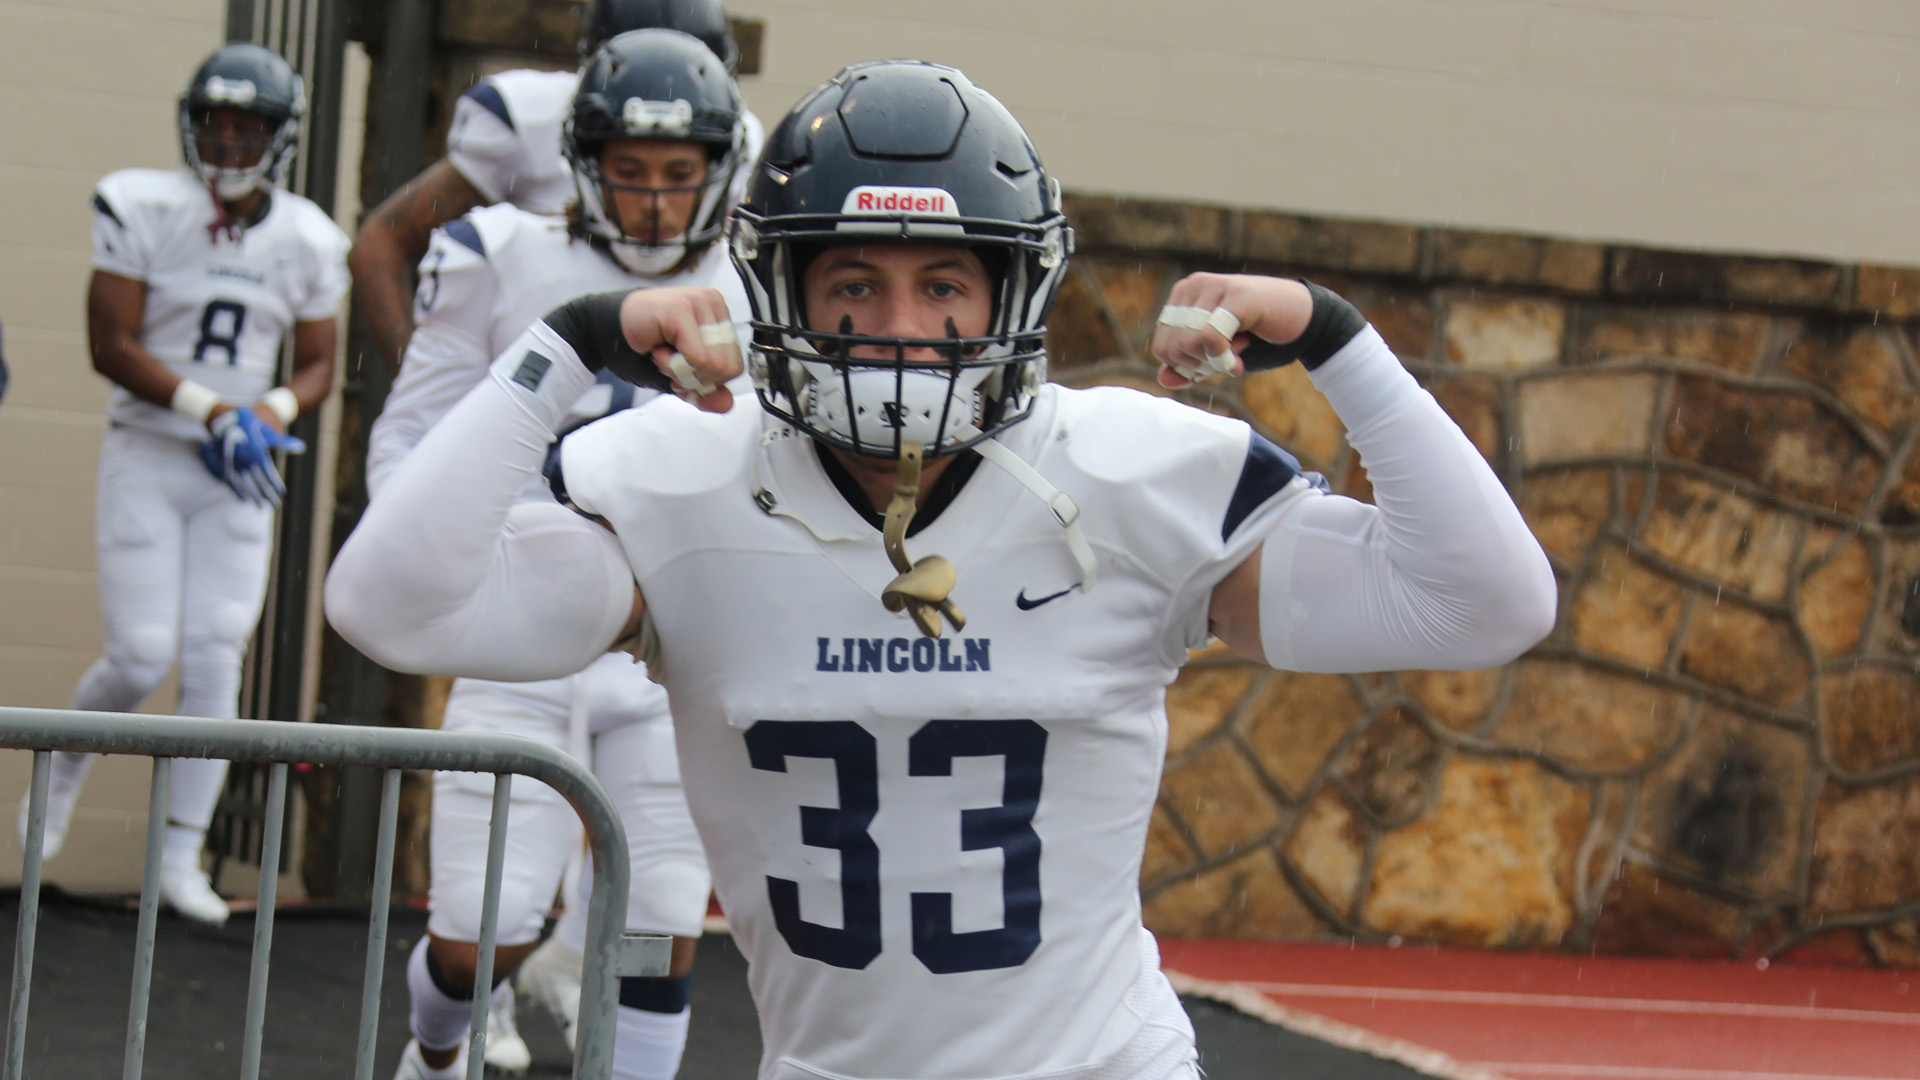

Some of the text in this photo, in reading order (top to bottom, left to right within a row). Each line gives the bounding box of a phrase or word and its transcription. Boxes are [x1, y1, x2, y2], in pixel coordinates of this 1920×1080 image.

[857, 192, 945, 212] Riddell
[193, 300, 246, 366] 8
[816, 637, 991, 673] LINCOLN
[743, 719, 1048, 974] 33
